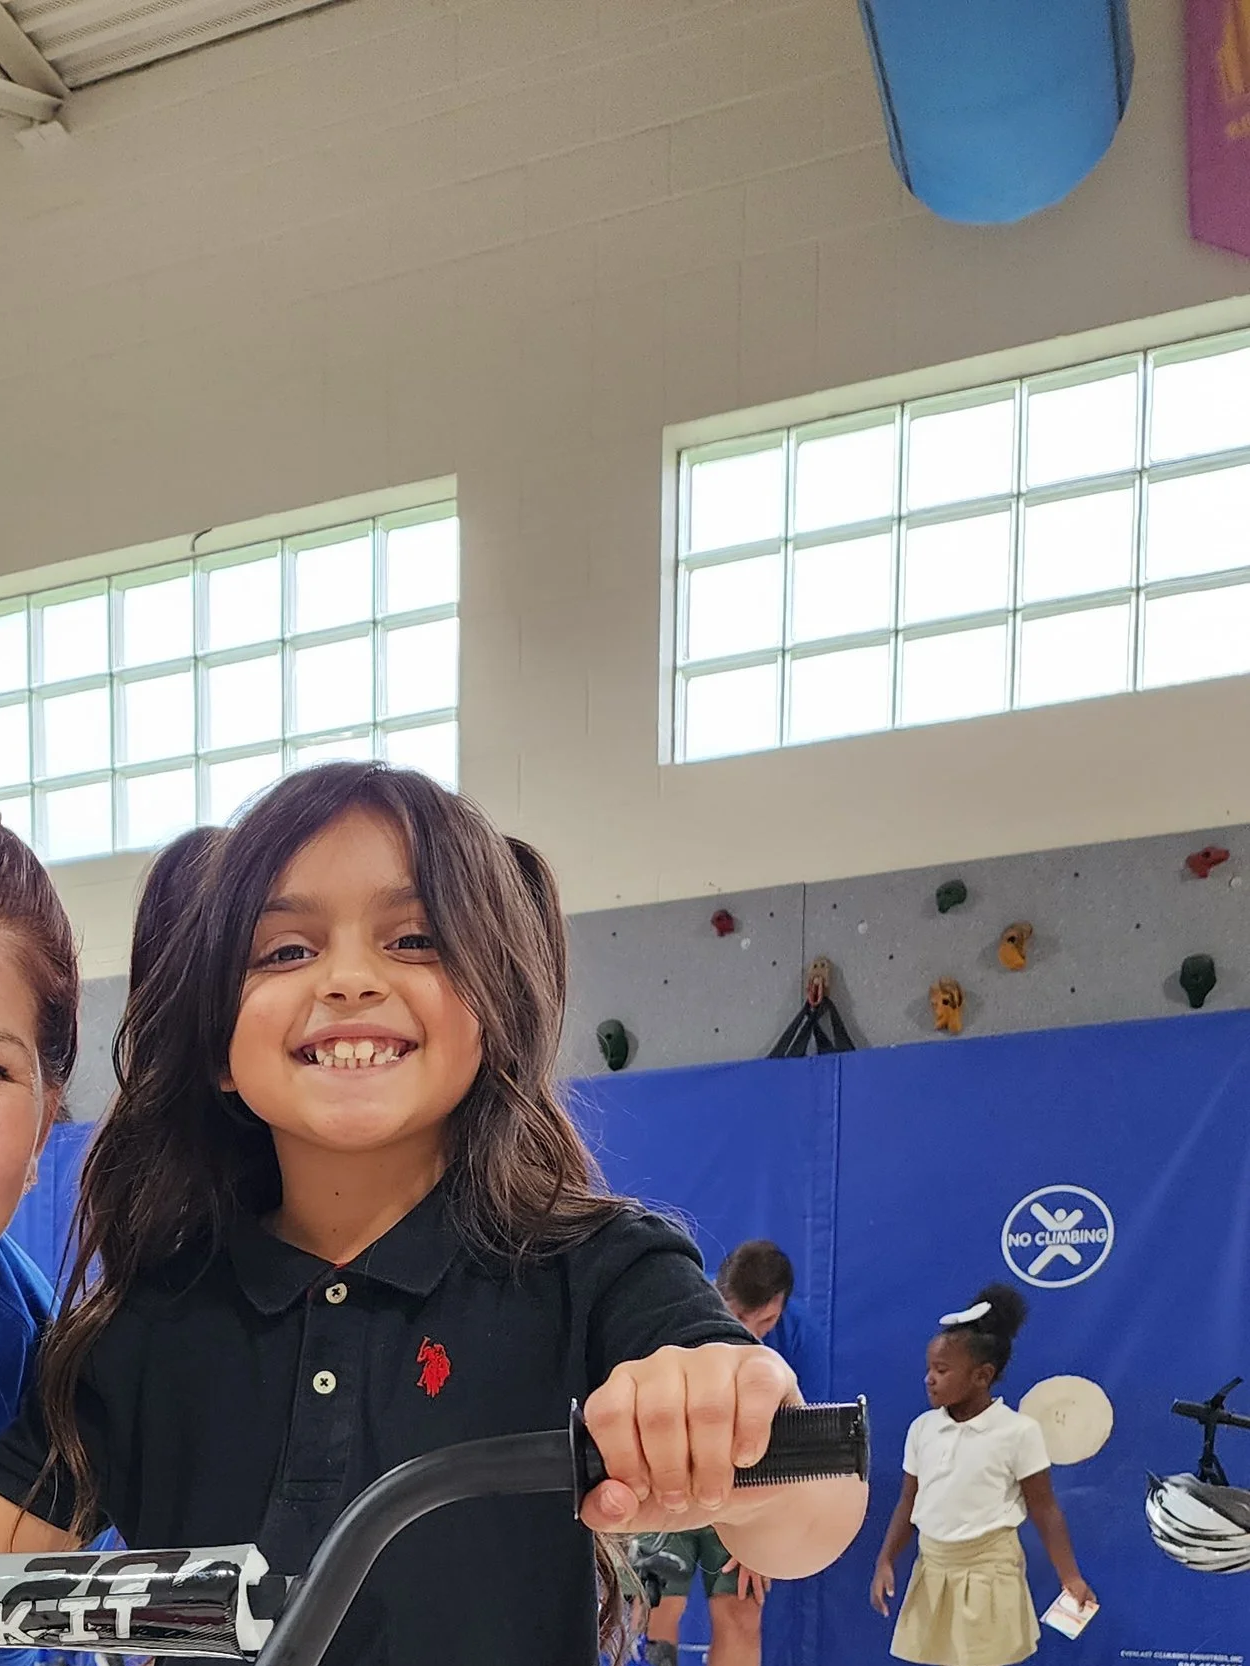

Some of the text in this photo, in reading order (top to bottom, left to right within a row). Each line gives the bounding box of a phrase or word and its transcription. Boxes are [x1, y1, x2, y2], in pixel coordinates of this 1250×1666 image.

[1008, 1228, 1108, 1247] NO CLIMBING
[57, 1594, 152, 1643] IT
